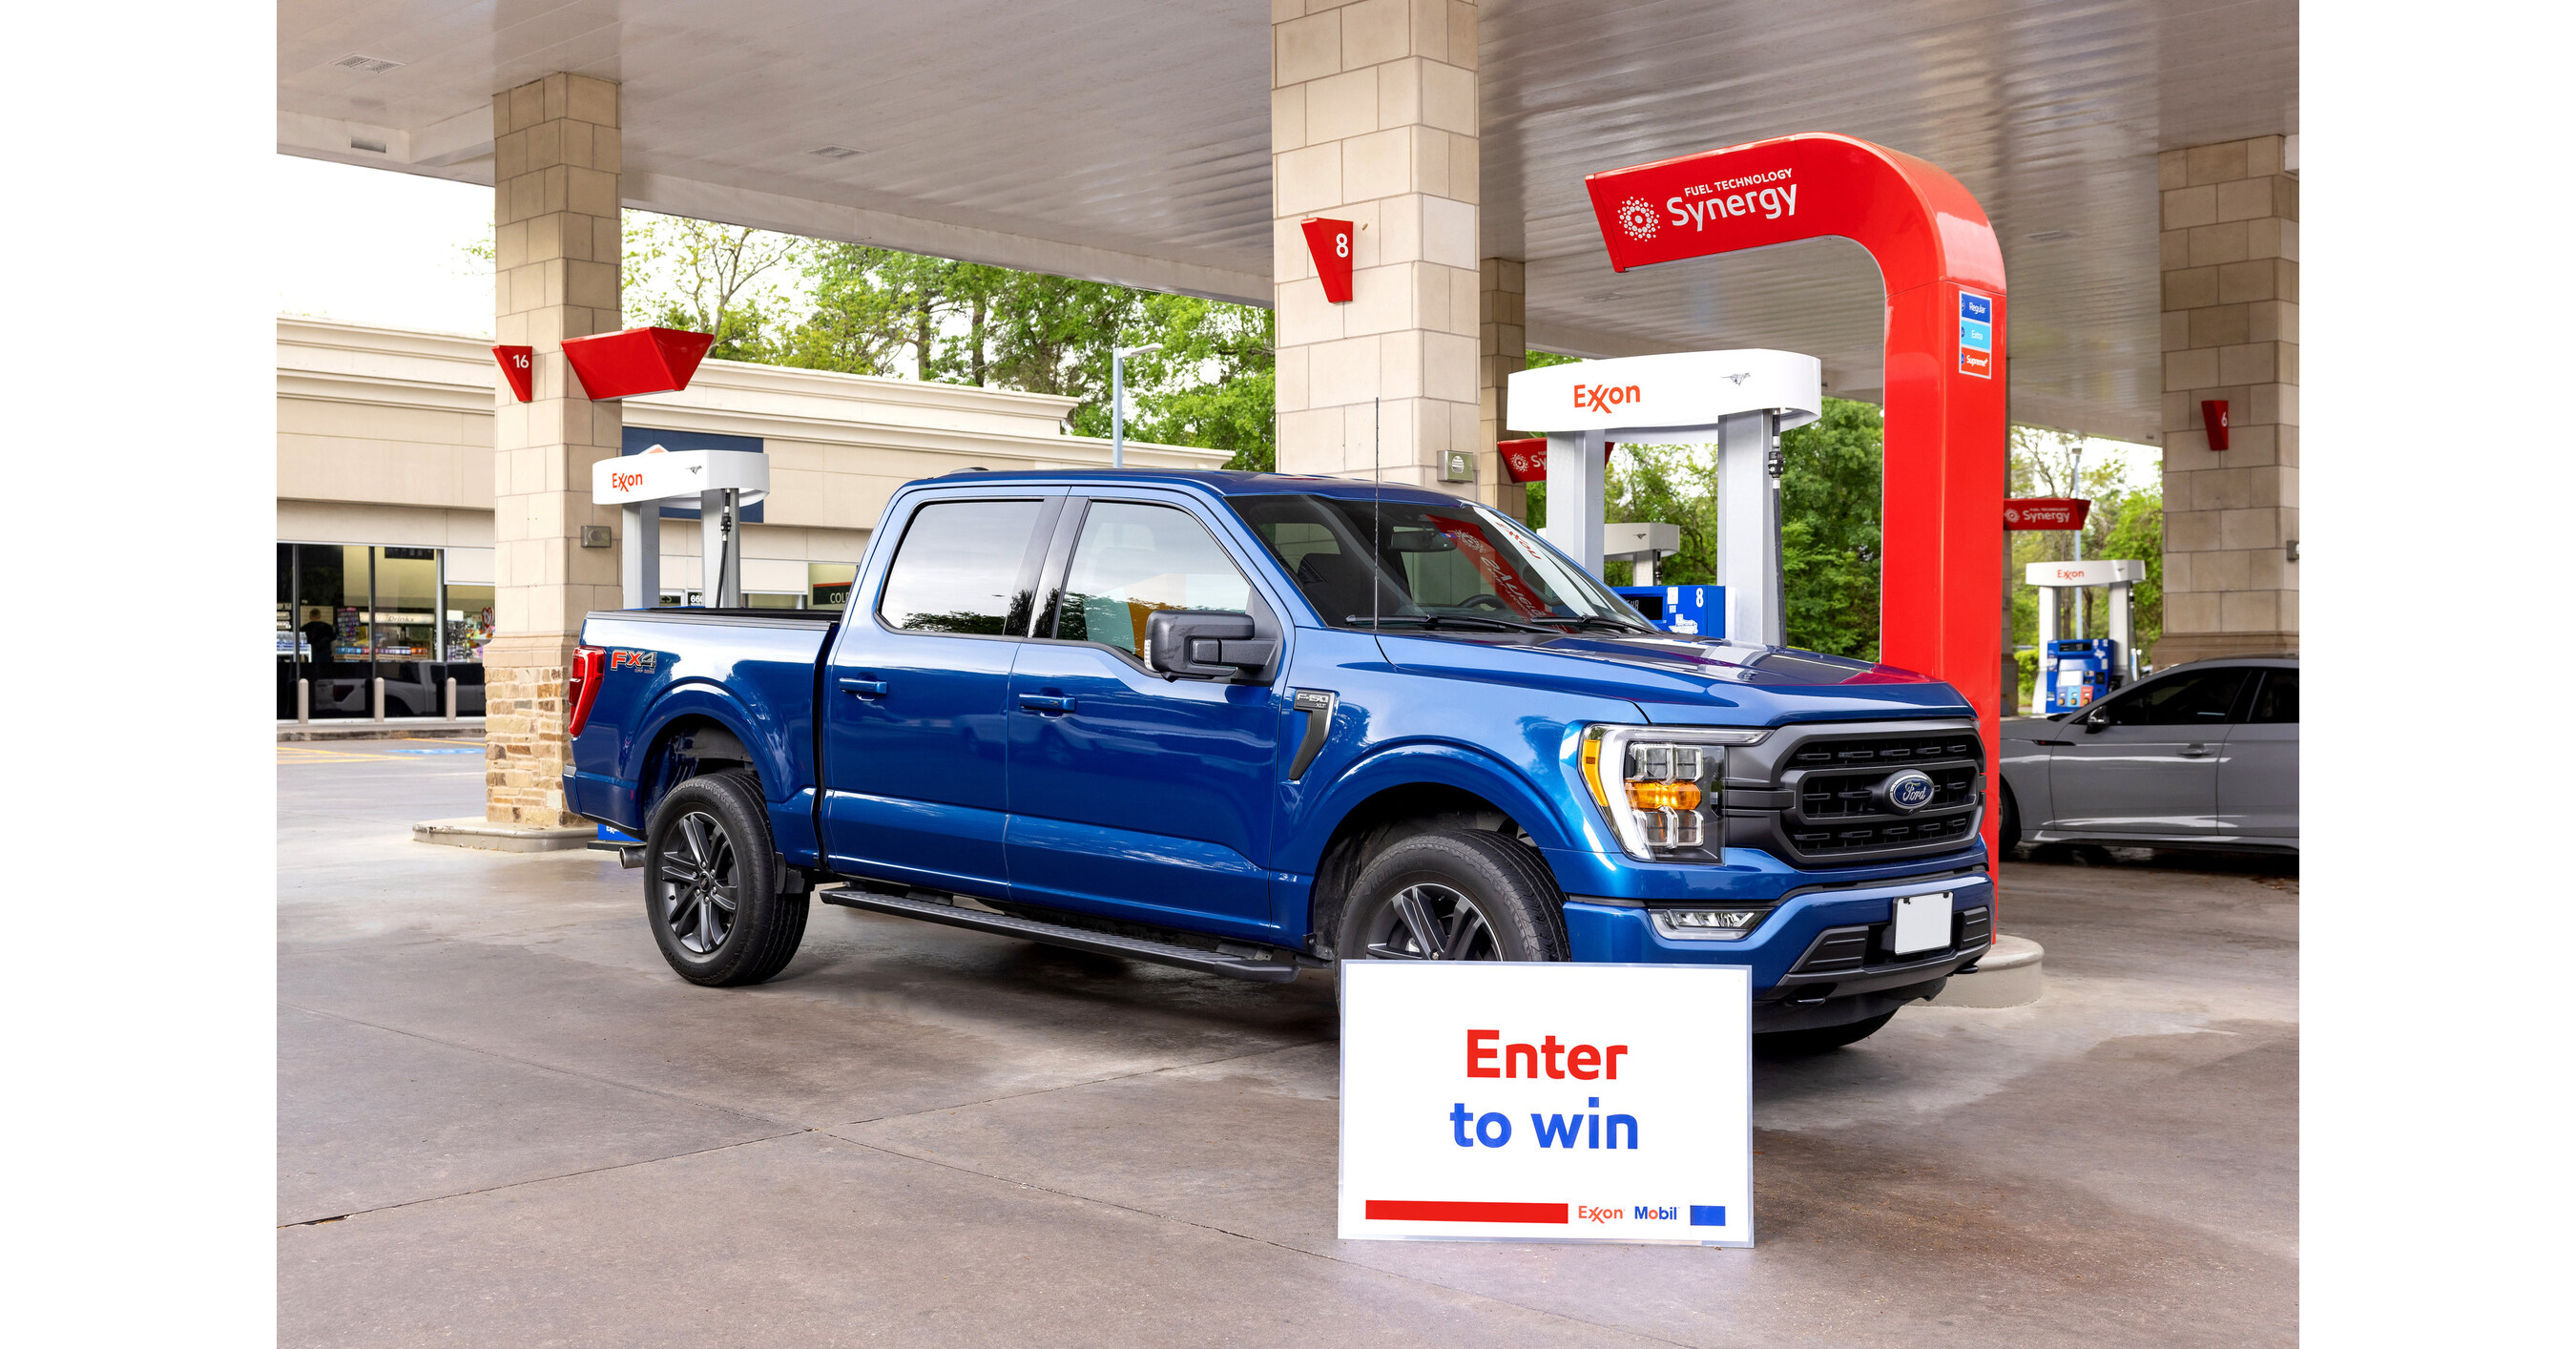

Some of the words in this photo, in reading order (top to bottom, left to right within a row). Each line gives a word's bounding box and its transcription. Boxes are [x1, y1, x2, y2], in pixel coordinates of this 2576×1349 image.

[1684, 184, 1713, 197] FUEL
[1714, 168, 1793, 191] TECHNOLOGY
[1666, 183, 1797, 232] Synergy
[1336, 233, 1349, 258] 8
[1968, 301, 1985, 315] Regular
[1971, 329, 1984, 341] Extra
[512, 354, 530, 368] 16
[1573, 384, 1641, 414] Exxon
[2221, 411, 2228, 427] 6
[612, 472, 643, 492] Exxon
[2023, 509, 2069, 523] Synergy
[2057, 570, 2085, 580] Exxon
[1696, 588, 1703, 608] 8
[611, 650, 657, 671] FX4
[1298, 693, 1329, 703] F-150
[1902, 781, 1927, 801] Ford
[1466, 1028, 1629, 1081] Enter
[1449, 1102, 1512, 1149] to
[1530, 1096, 1638, 1150] win
[1578, 1205, 1624, 1224] Exxon
[1634, 1205, 1677, 1220] Mobil
